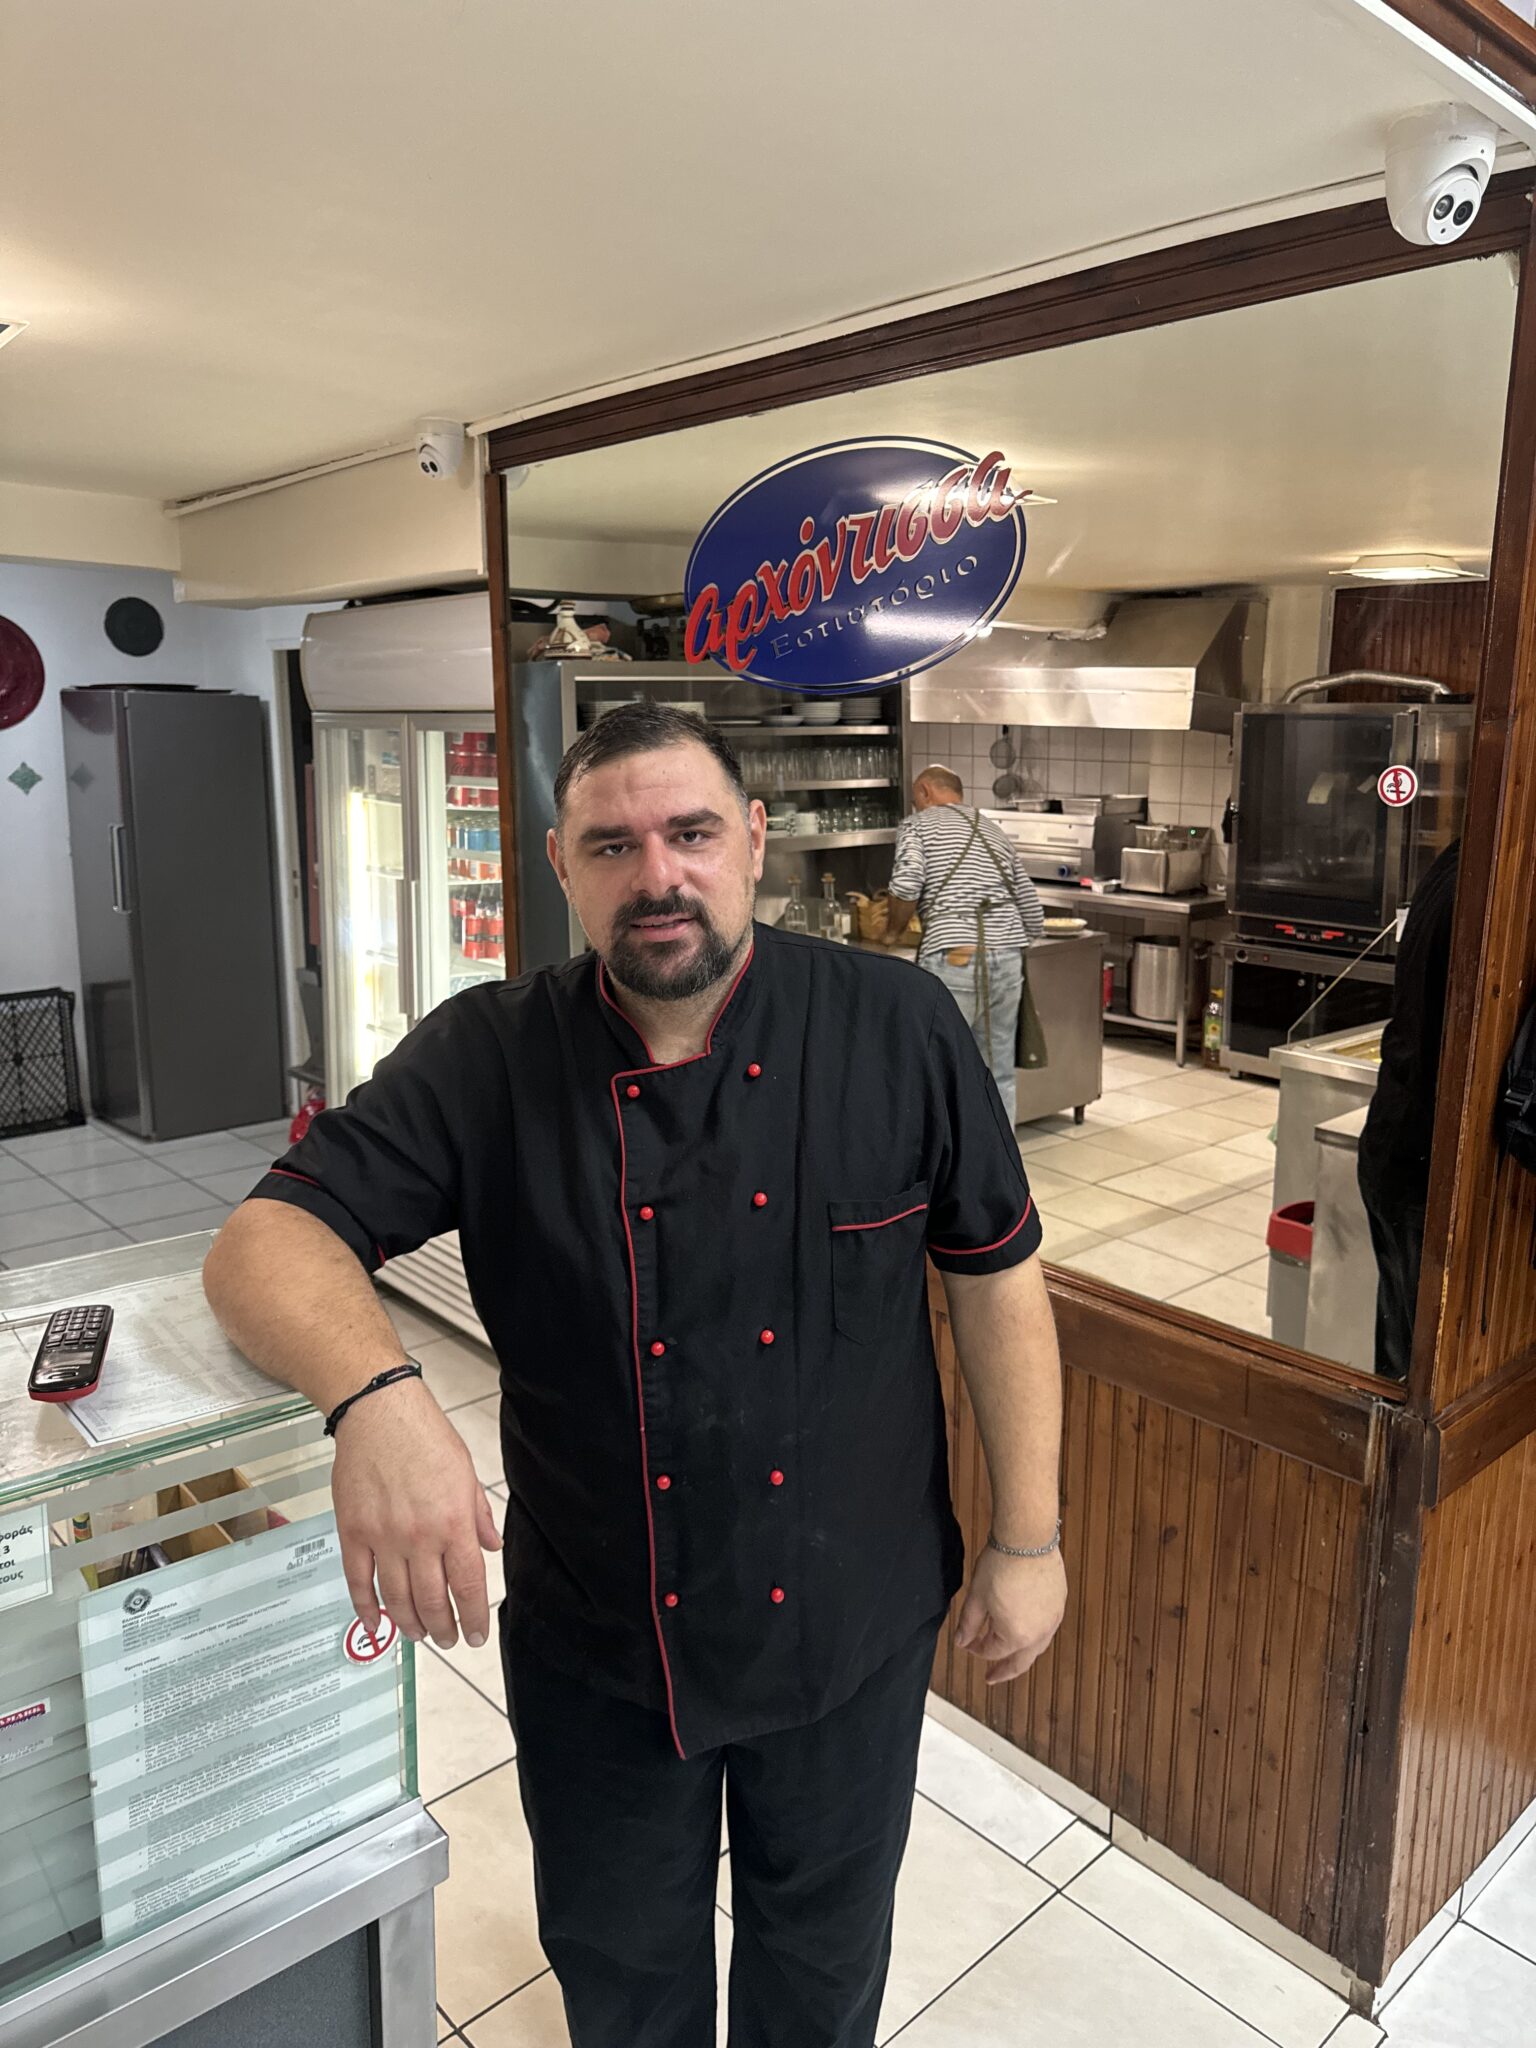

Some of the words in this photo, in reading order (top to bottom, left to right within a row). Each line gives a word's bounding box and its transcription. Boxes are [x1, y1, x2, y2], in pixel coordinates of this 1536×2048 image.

[684, 450, 1033, 672] αρχόντισσα
[770, 553, 979, 661] Εστιατόριο
[3, 1545, 10, 1554] 3
